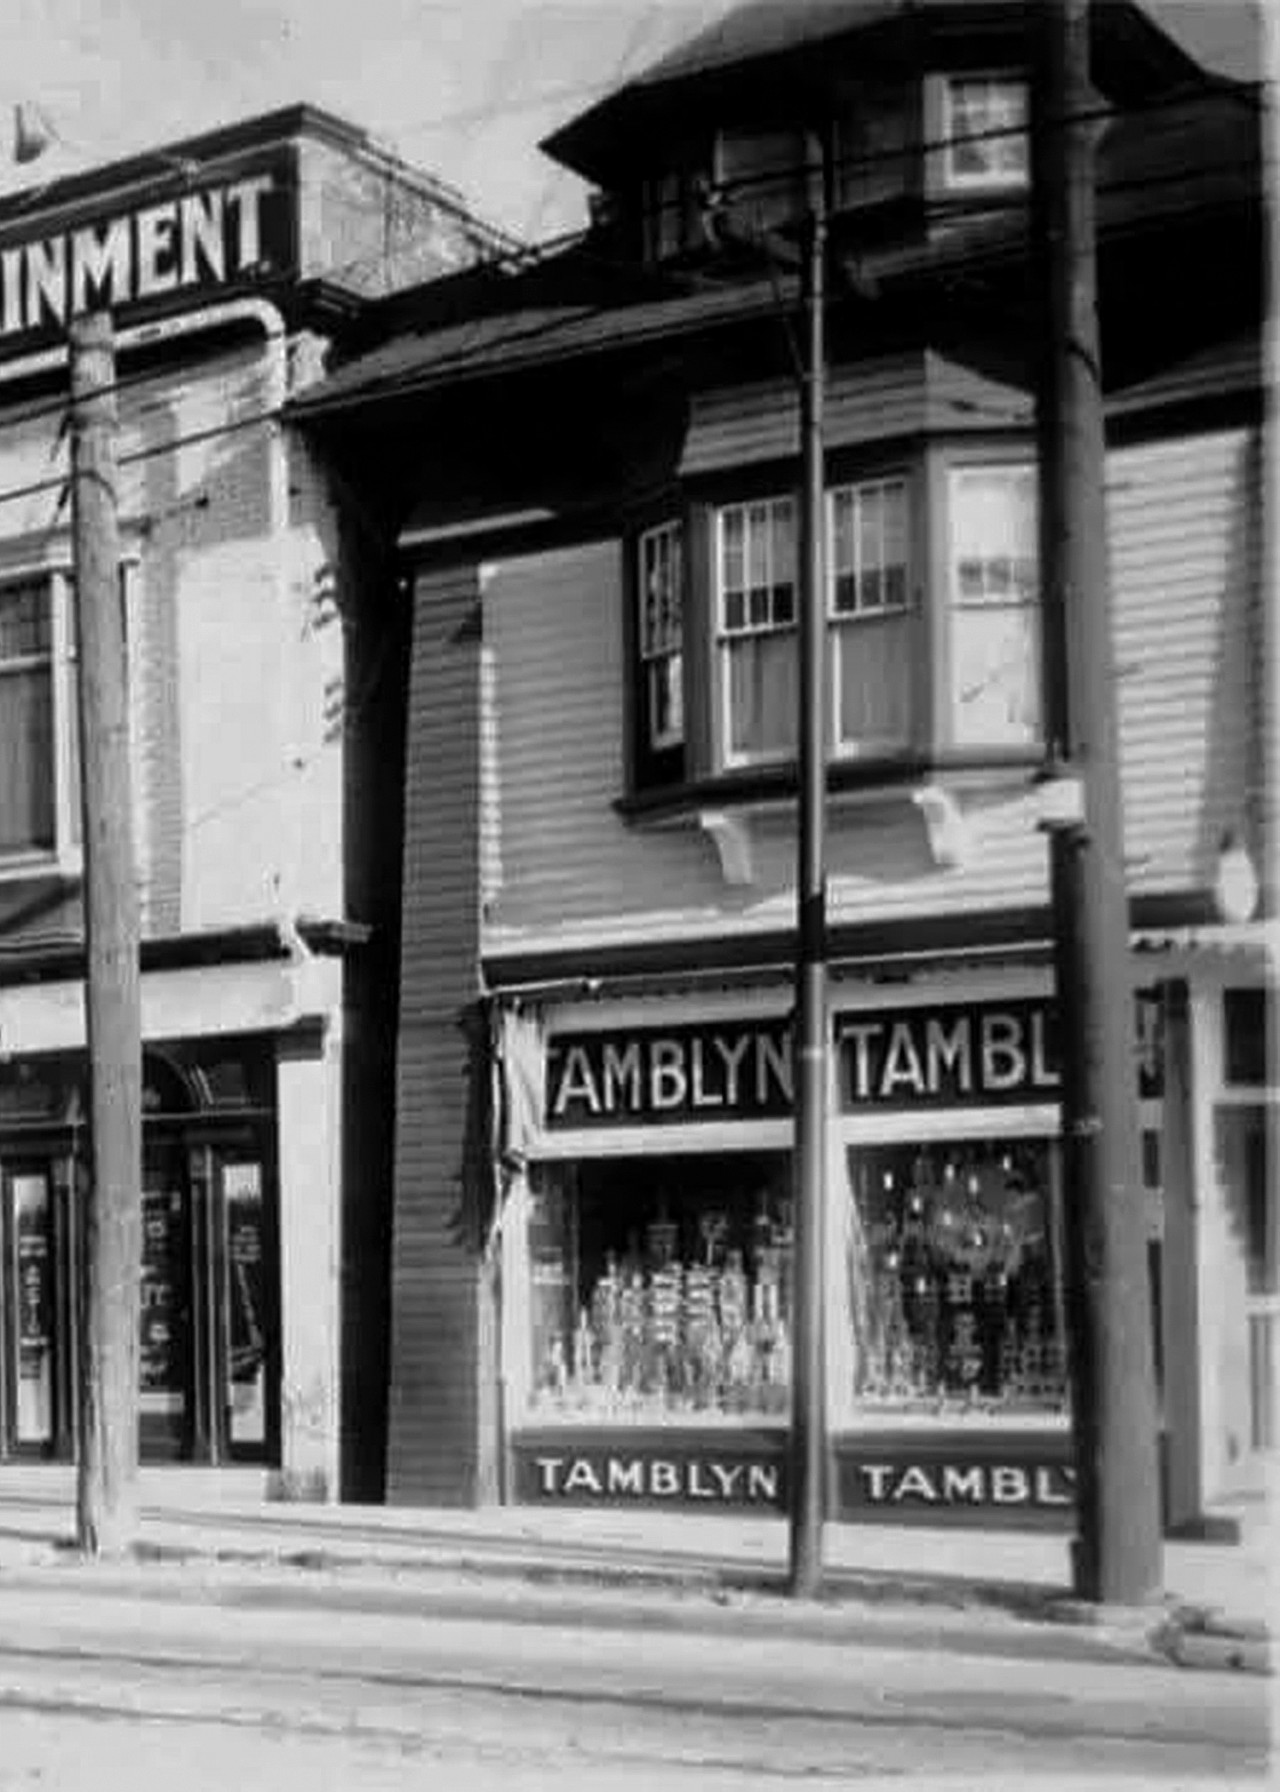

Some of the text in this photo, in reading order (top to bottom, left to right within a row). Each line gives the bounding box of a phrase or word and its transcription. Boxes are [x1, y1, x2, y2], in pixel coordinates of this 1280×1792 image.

[841, 1010, 1062, 1098] TAMBL
[536, 1457, 780, 1498] TAMBLYN
[862, 1464, 1076, 1505] TAMBL
